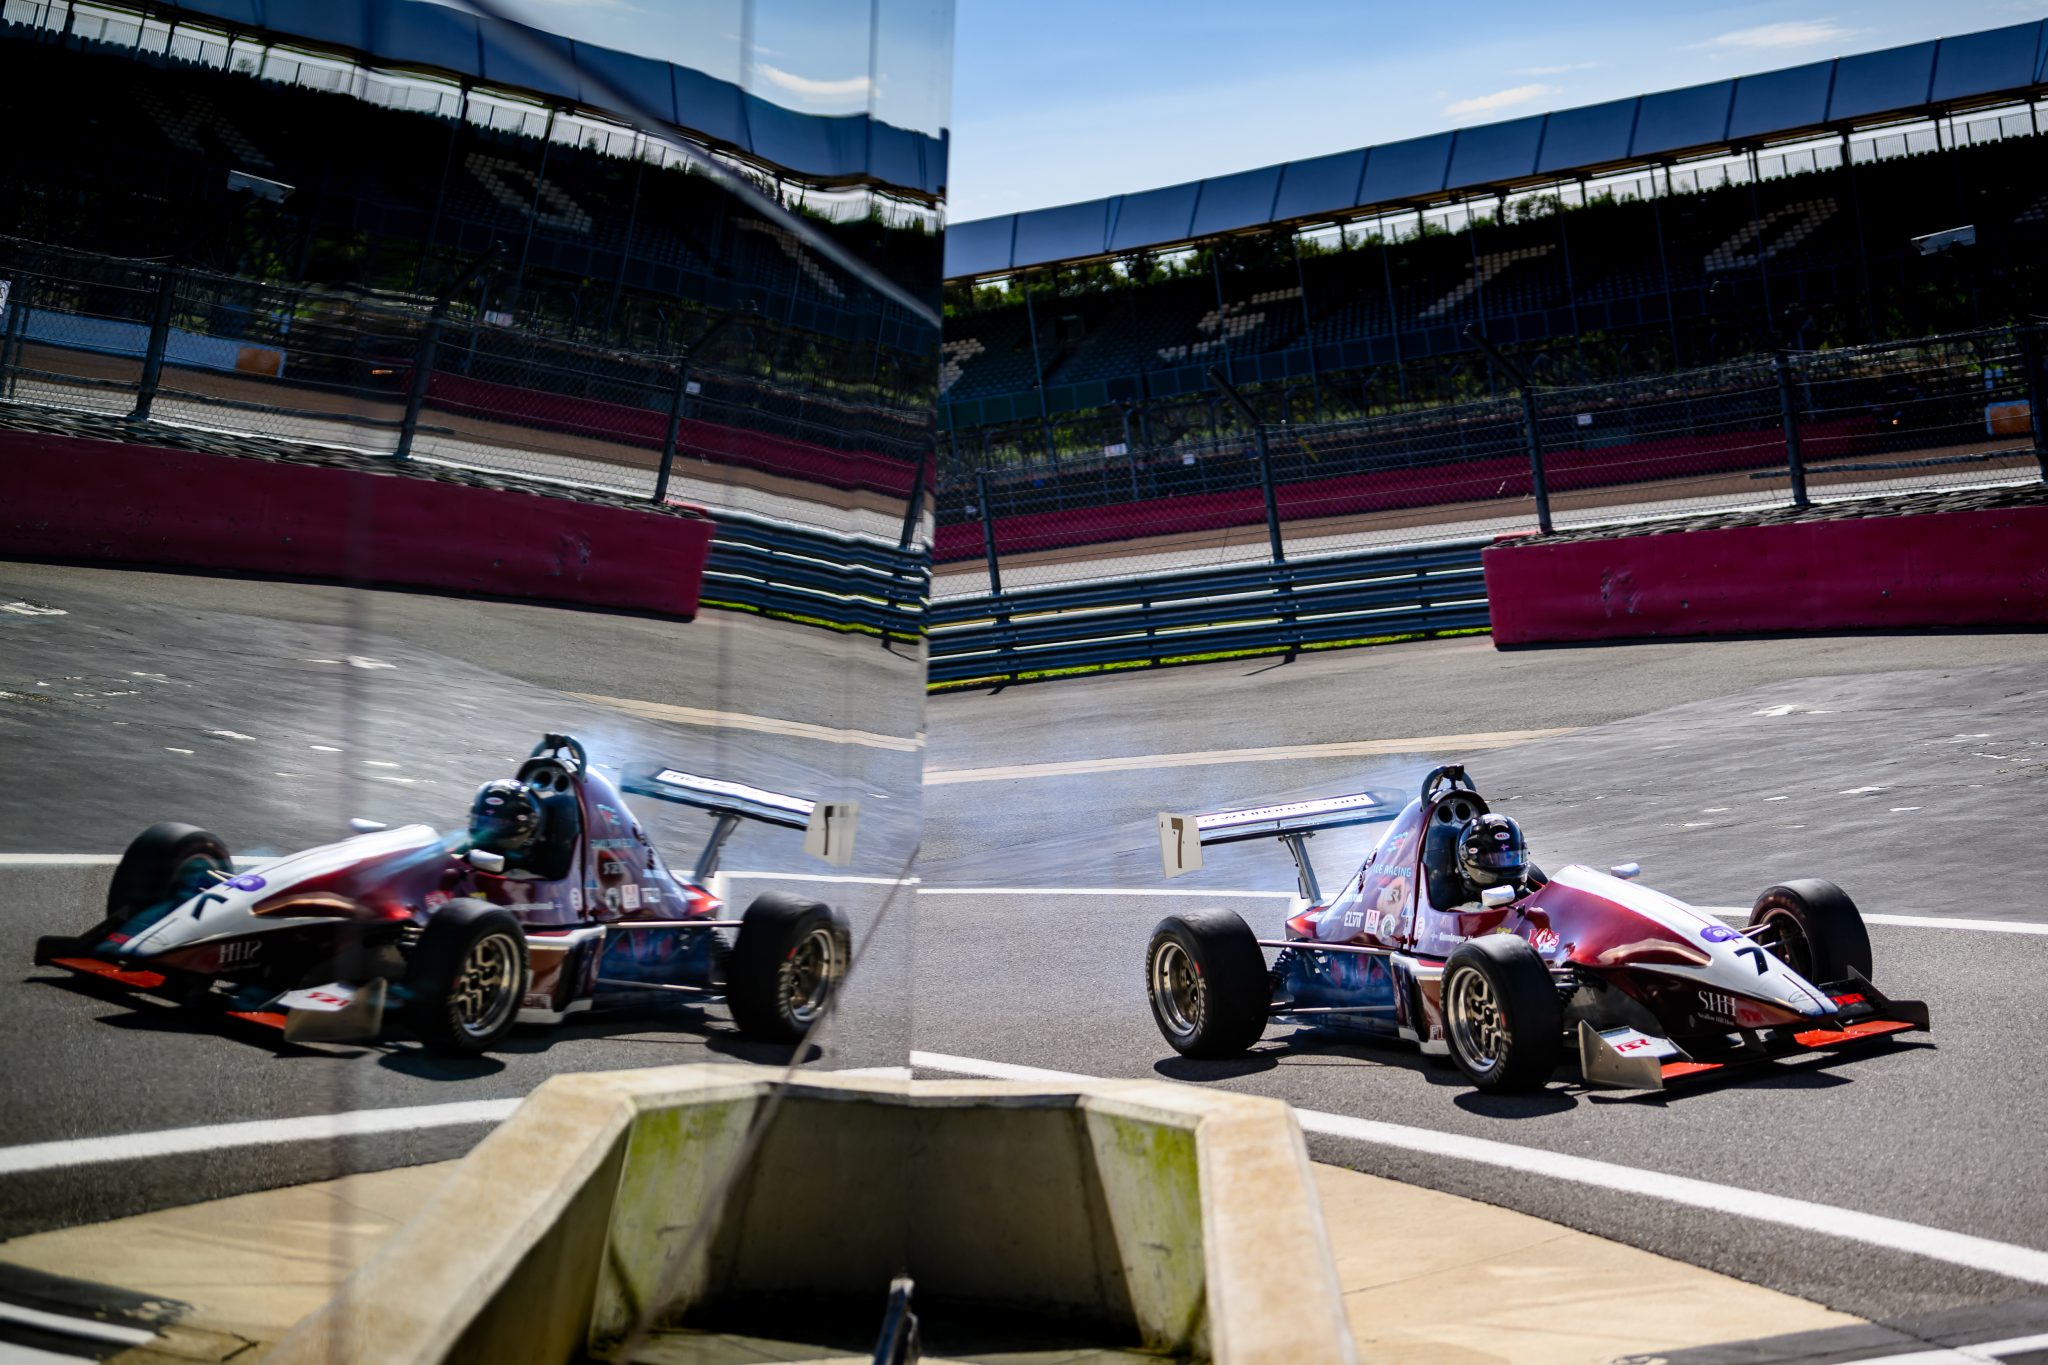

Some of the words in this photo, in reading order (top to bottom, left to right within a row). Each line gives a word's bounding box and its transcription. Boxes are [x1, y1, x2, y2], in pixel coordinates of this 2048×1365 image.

[1171, 817, 1184, 868] 7
[1384, 865, 1412, 878] RACING
[1734, 947, 1769, 976] 7
[1698, 990, 1736, 1017] SHH
